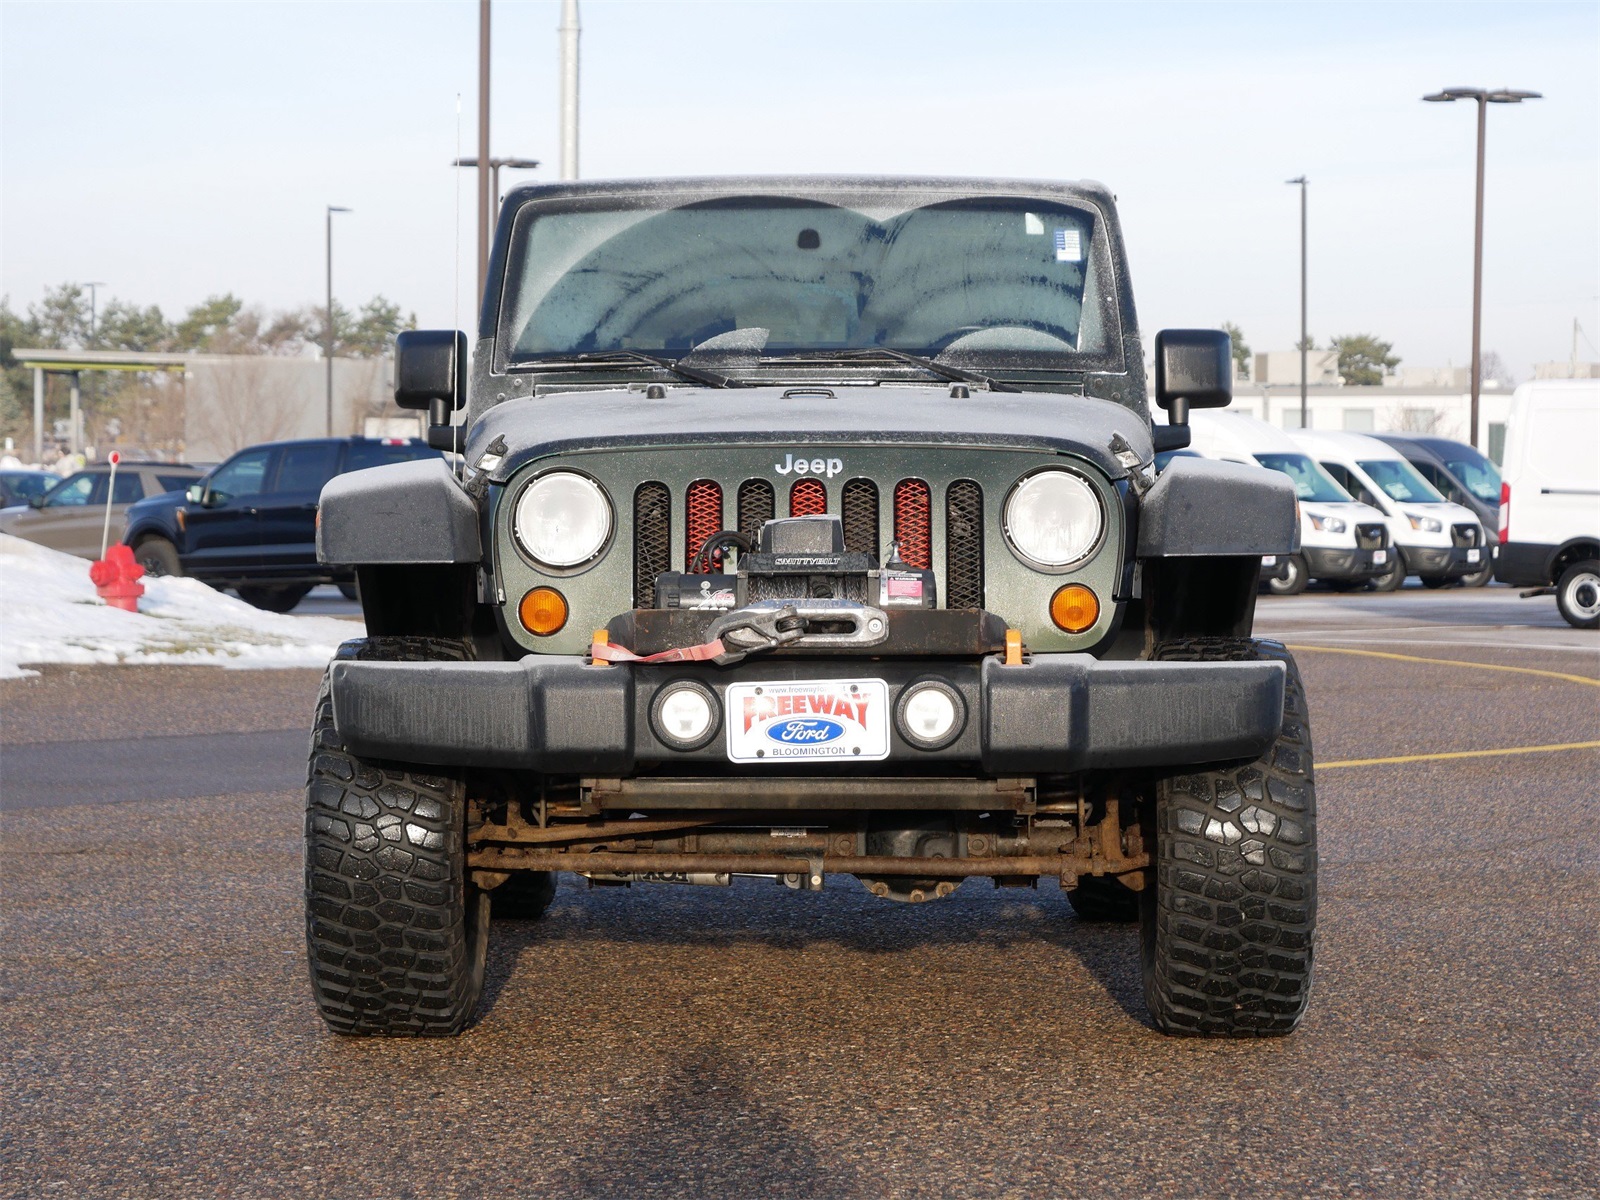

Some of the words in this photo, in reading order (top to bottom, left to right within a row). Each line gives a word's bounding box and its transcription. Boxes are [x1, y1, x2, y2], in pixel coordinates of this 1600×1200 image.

[775, 453, 843, 478] Jeep
[743, 692, 871, 736] FREEWAY
[781, 721, 829, 741] Ford
[772, 746, 846, 756] BLOOMINGTON
